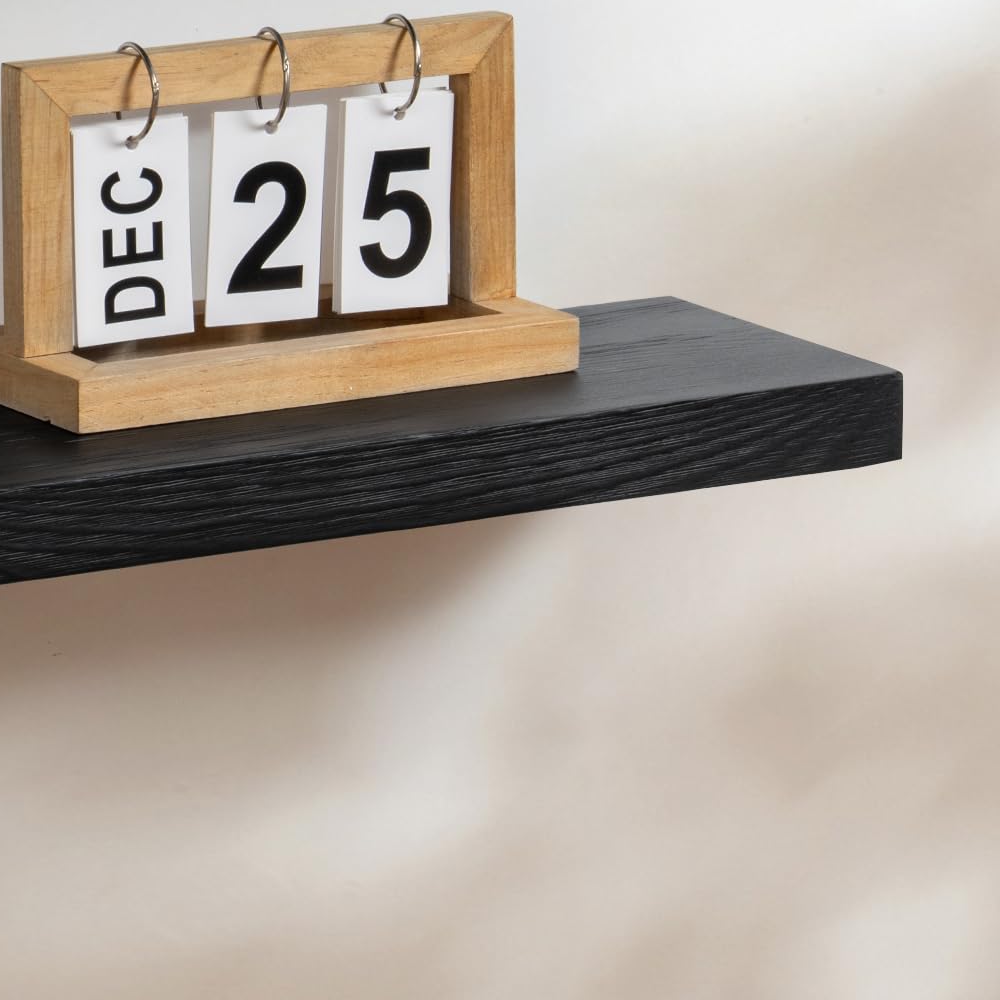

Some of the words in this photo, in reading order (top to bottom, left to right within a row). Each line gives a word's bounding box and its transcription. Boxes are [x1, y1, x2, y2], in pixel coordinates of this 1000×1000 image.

[100, 167, 166, 325] DEC
[227, 160, 307, 294] 2
[359, 147, 433, 279] 5
